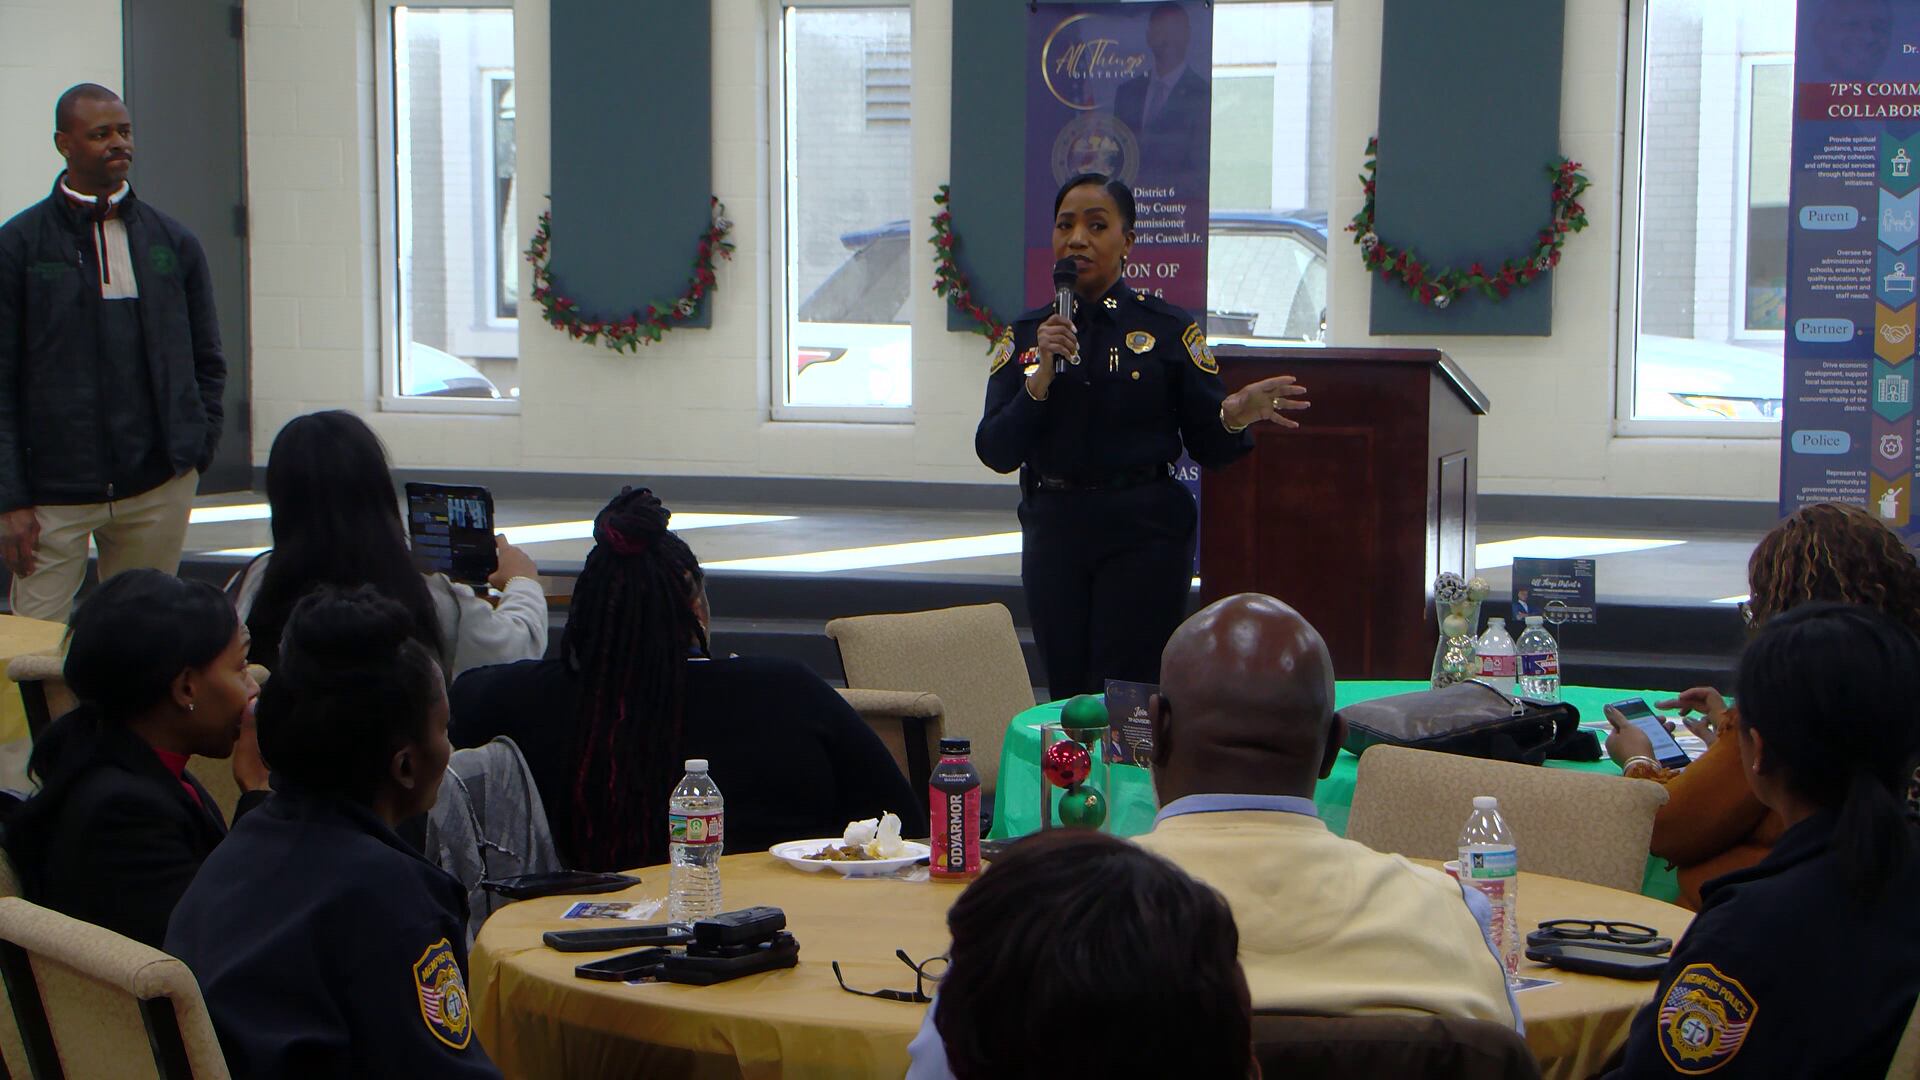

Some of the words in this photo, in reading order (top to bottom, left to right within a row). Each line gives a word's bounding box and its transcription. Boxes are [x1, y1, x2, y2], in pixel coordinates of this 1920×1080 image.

[1903, 44, 1919, 54] Dr.
[1056, 43, 1086, 78] All
[1087, 39, 1145, 74] Things
[1828, 104, 1920, 117] COLLABOR
[1134, 187, 1166, 197] District
[1169, 187, 1175, 197] 6
[1135, 203, 1151, 215] lby
[1153, 203, 1186, 215] County
[1808, 210, 1849, 222] Parent
[1155, 233, 1189, 243] Caswell
[1191, 233, 1203, 244] Jr.
[1157, 263, 1180, 278] OF
[1801, 323, 1848, 335] Partner
[1802, 434, 1840, 447] Police
[1719, 987, 1748, 1019] POLICE
